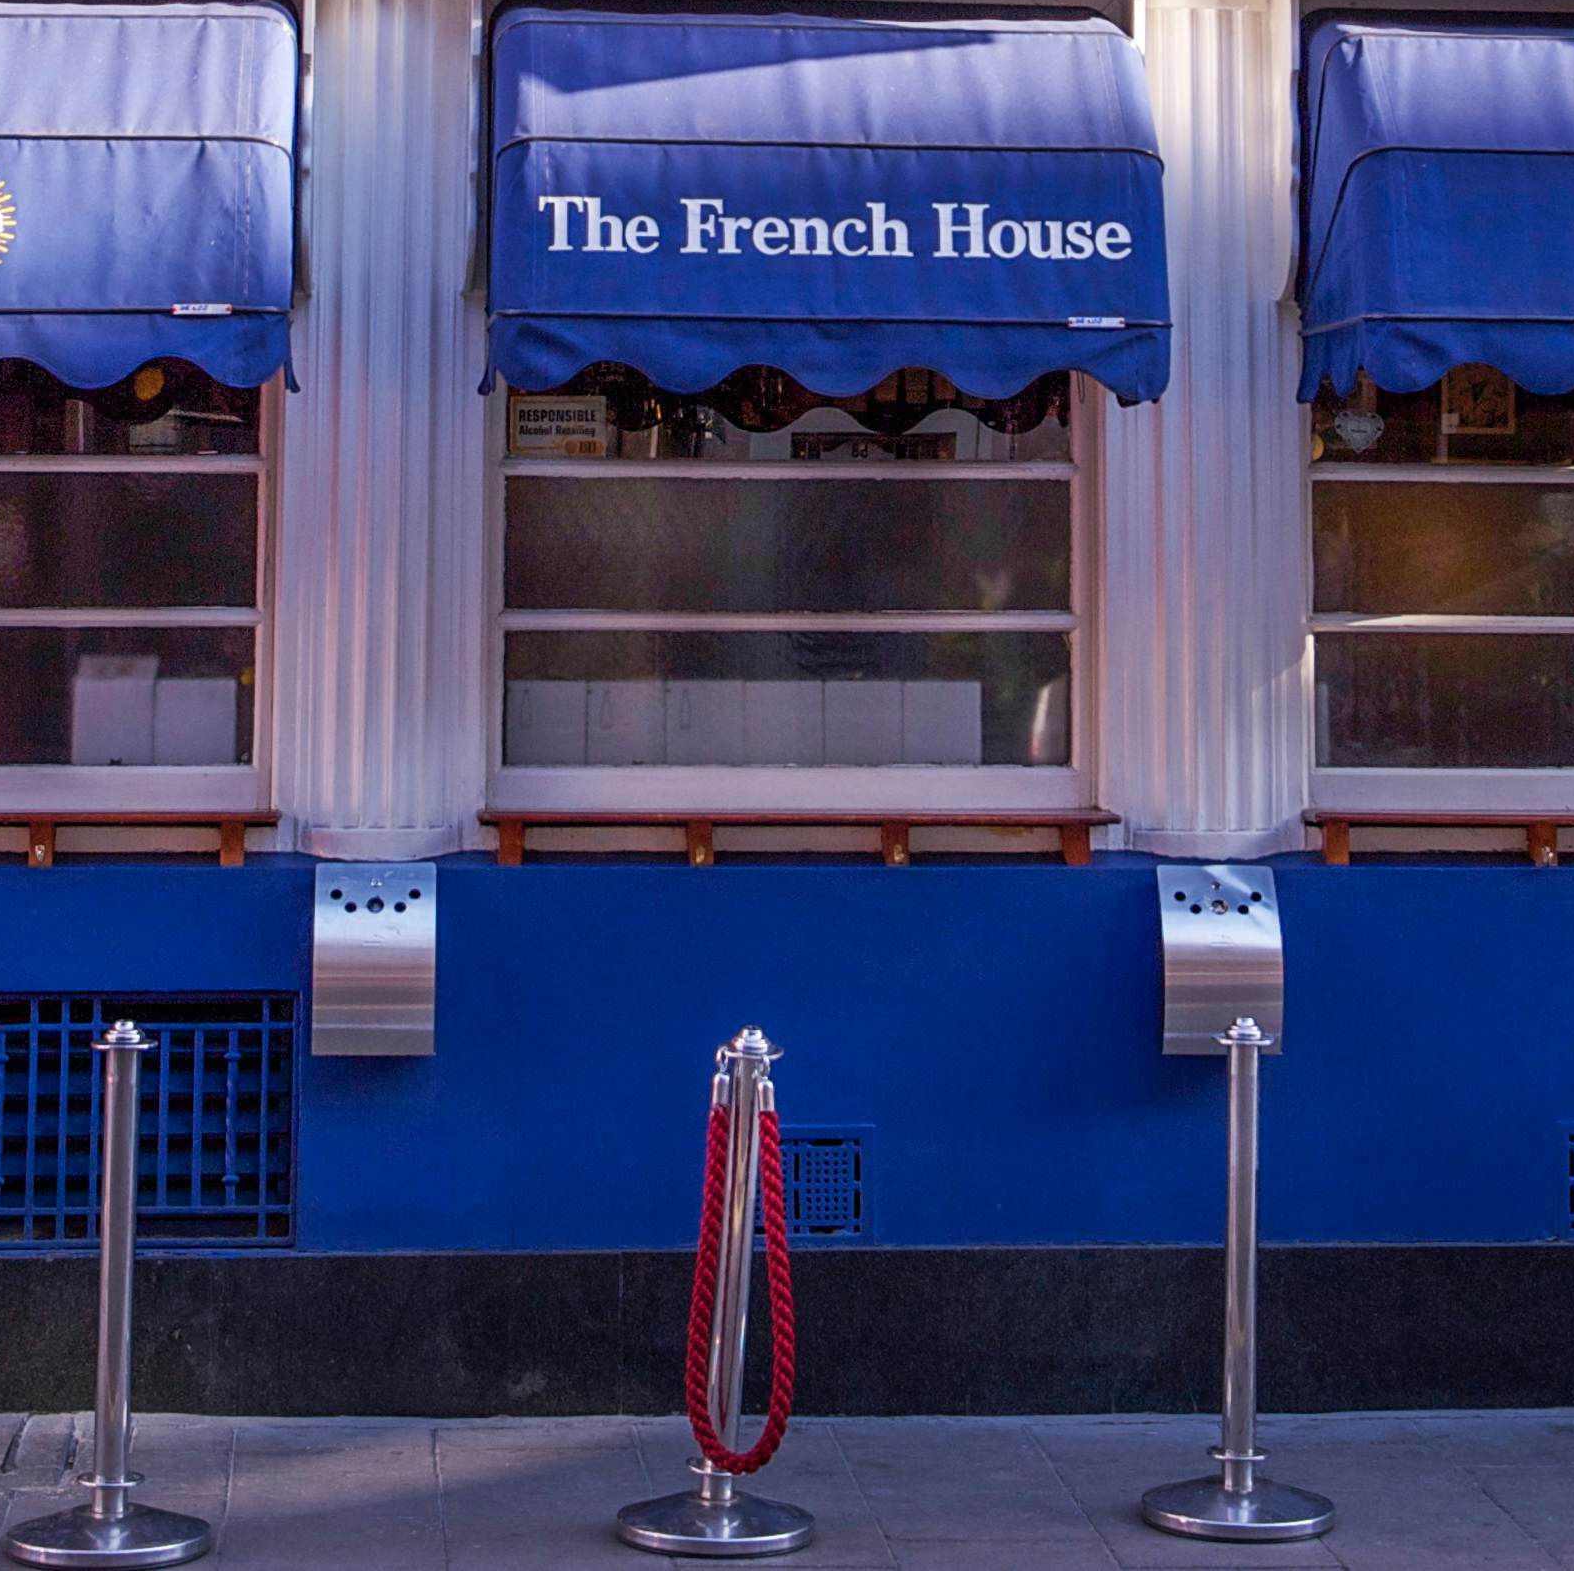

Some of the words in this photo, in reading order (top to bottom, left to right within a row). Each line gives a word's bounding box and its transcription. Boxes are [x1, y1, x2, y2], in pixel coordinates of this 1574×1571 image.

[539, 196, 660, 254] The
[680, 198, 914, 258] French
[932, 202, 1133, 260] House
[518, 409, 597, 422] RESPONSIBLE
[518, 425, 552, 436] Alcohol
